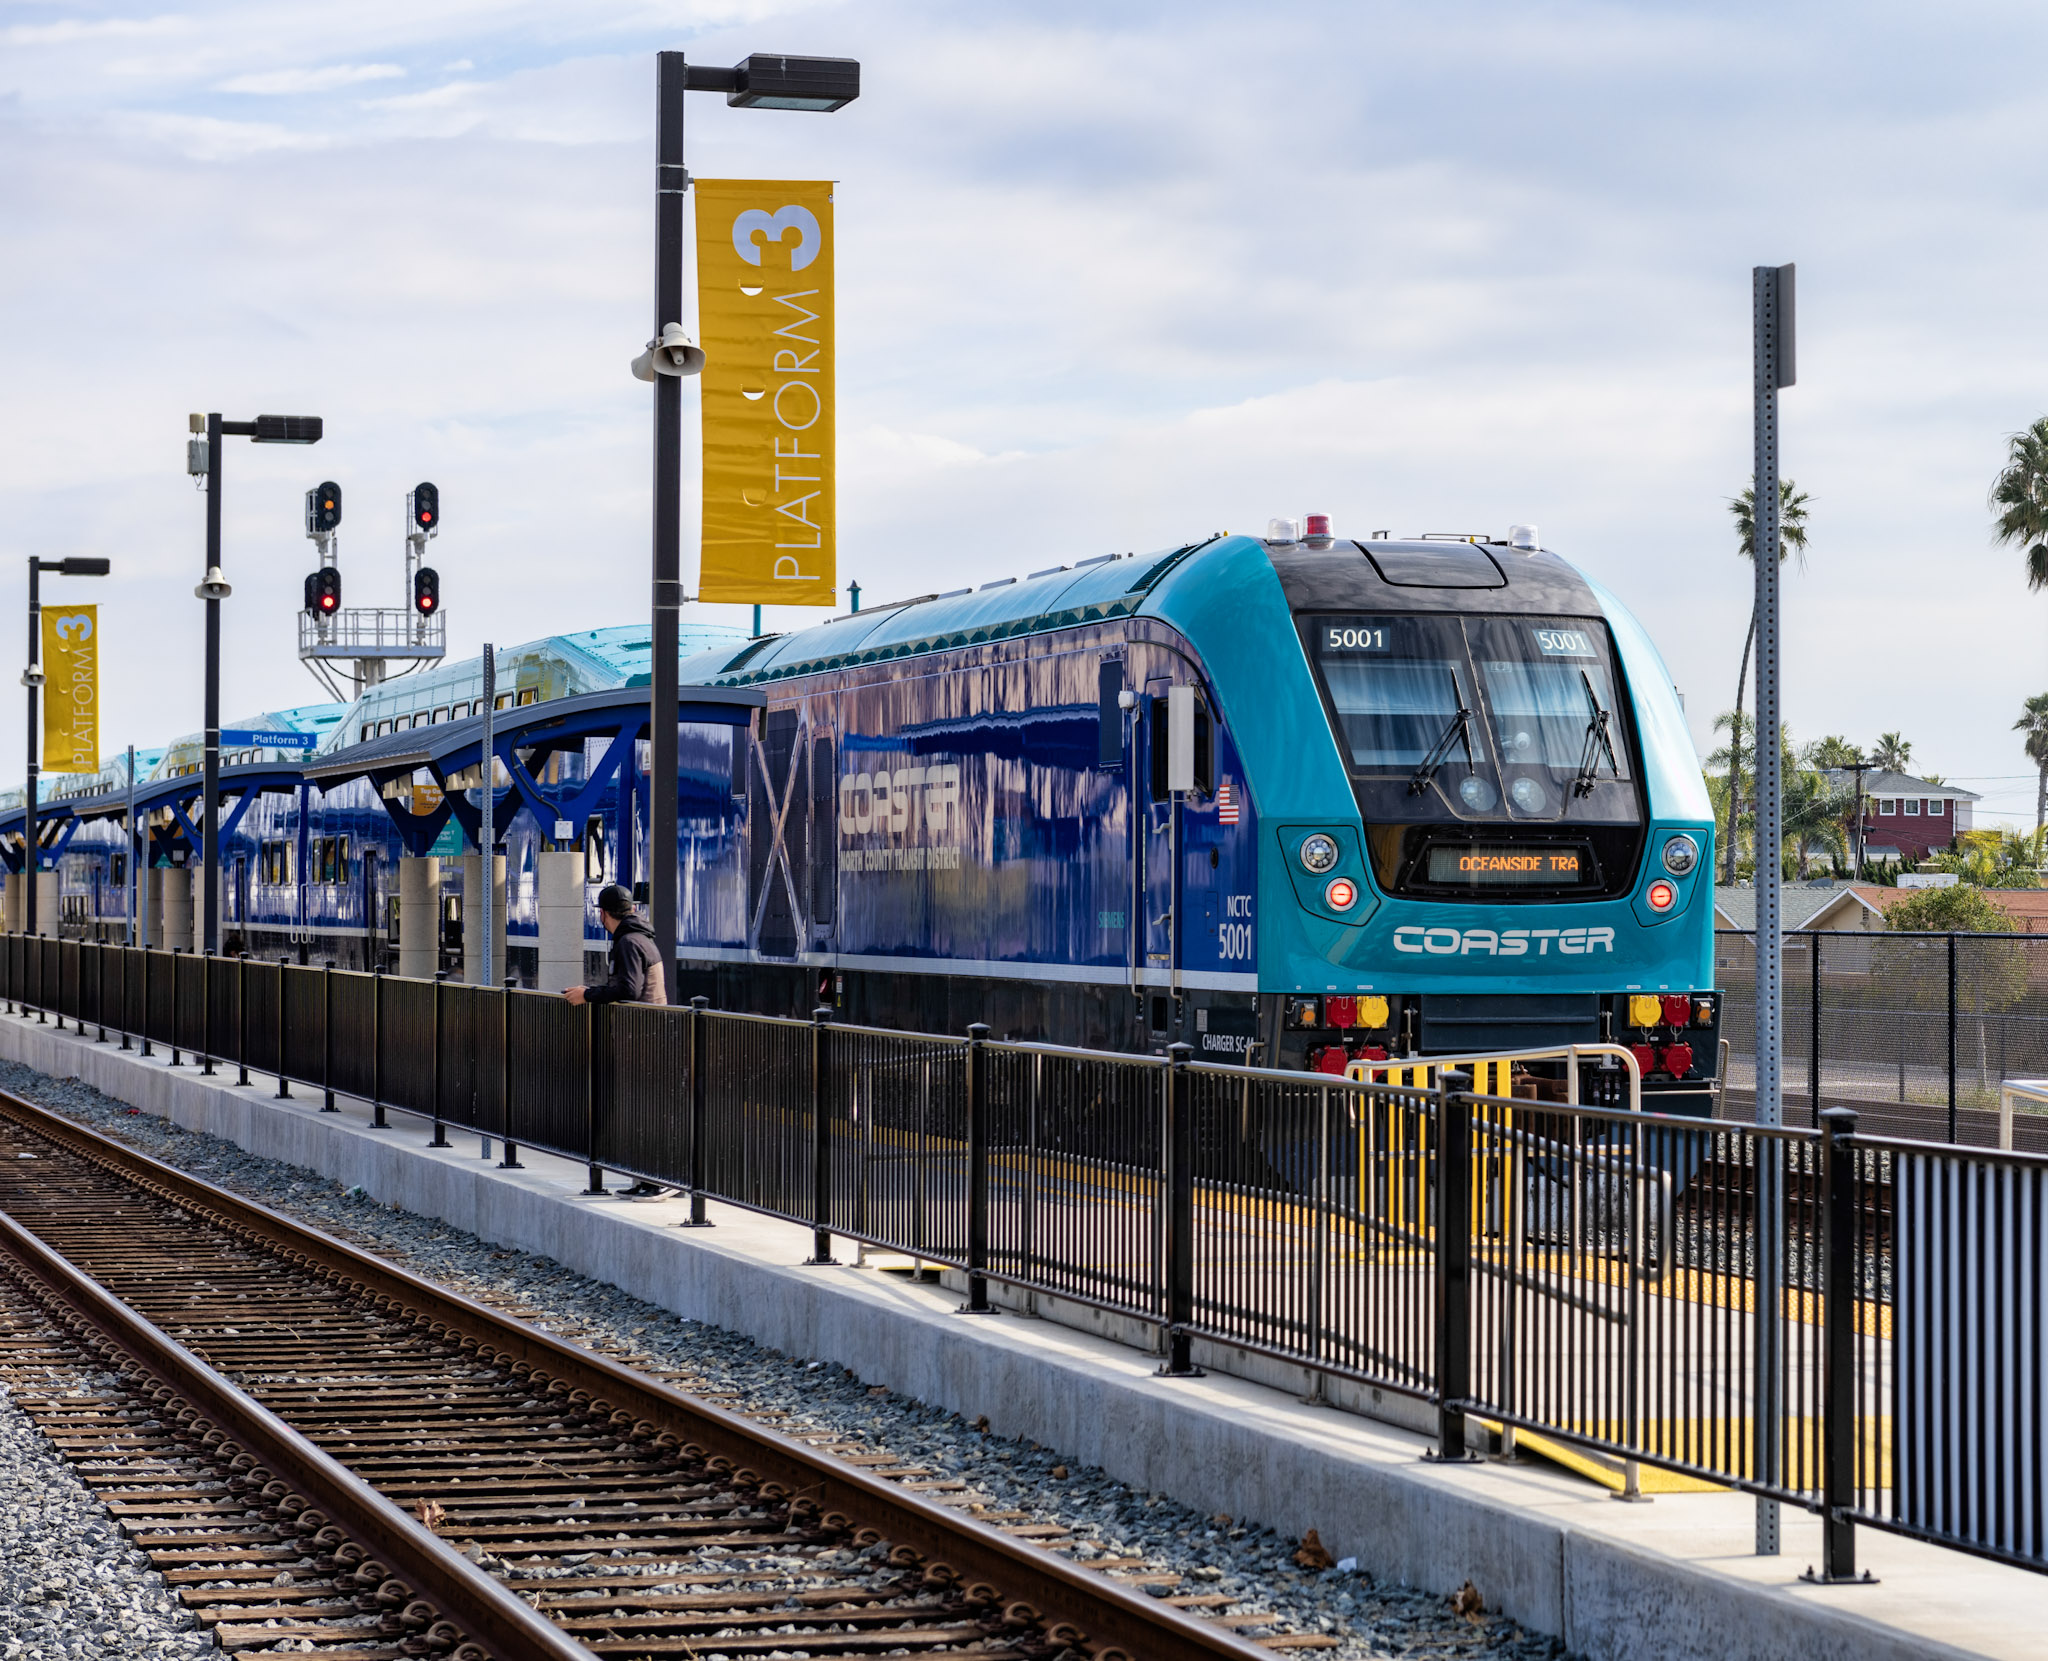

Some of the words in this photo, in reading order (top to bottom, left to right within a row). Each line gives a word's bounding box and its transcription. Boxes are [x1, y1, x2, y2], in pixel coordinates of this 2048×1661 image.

[732, 204, 821, 272] 3
[772, 288, 821, 580] PLATFORM
[56, 614, 93, 642] 3
[1329, 629, 1383, 648] 5001
[1539, 631, 1588, 651] 5001
[72, 647, 94, 765] PLATFORM
[252, 734, 299, 745] Platform
[302, 736, 309, 746] 3
[839, 763, 960, 835] COASTER
[839, 850, 863, 872] NORTH
[864, 849, 893, 872] COUNTY
[894, 847, 925, 871] TRANSIT
[926, 846, 960, 870] DISTRICT
[1459, 856, 1543, 872] OCEANSIDE
[1551, 856, 1579, 872] TRA
[1227, 895, 1252, 917] NCTC
[1098, 911, 1125, 929] SIEMENS
[1219, 923, 1252, 961] 5001
[1393, 925, 1616, 956] COASTER
[1202, 1033, 1235, 1052] CHARGER
